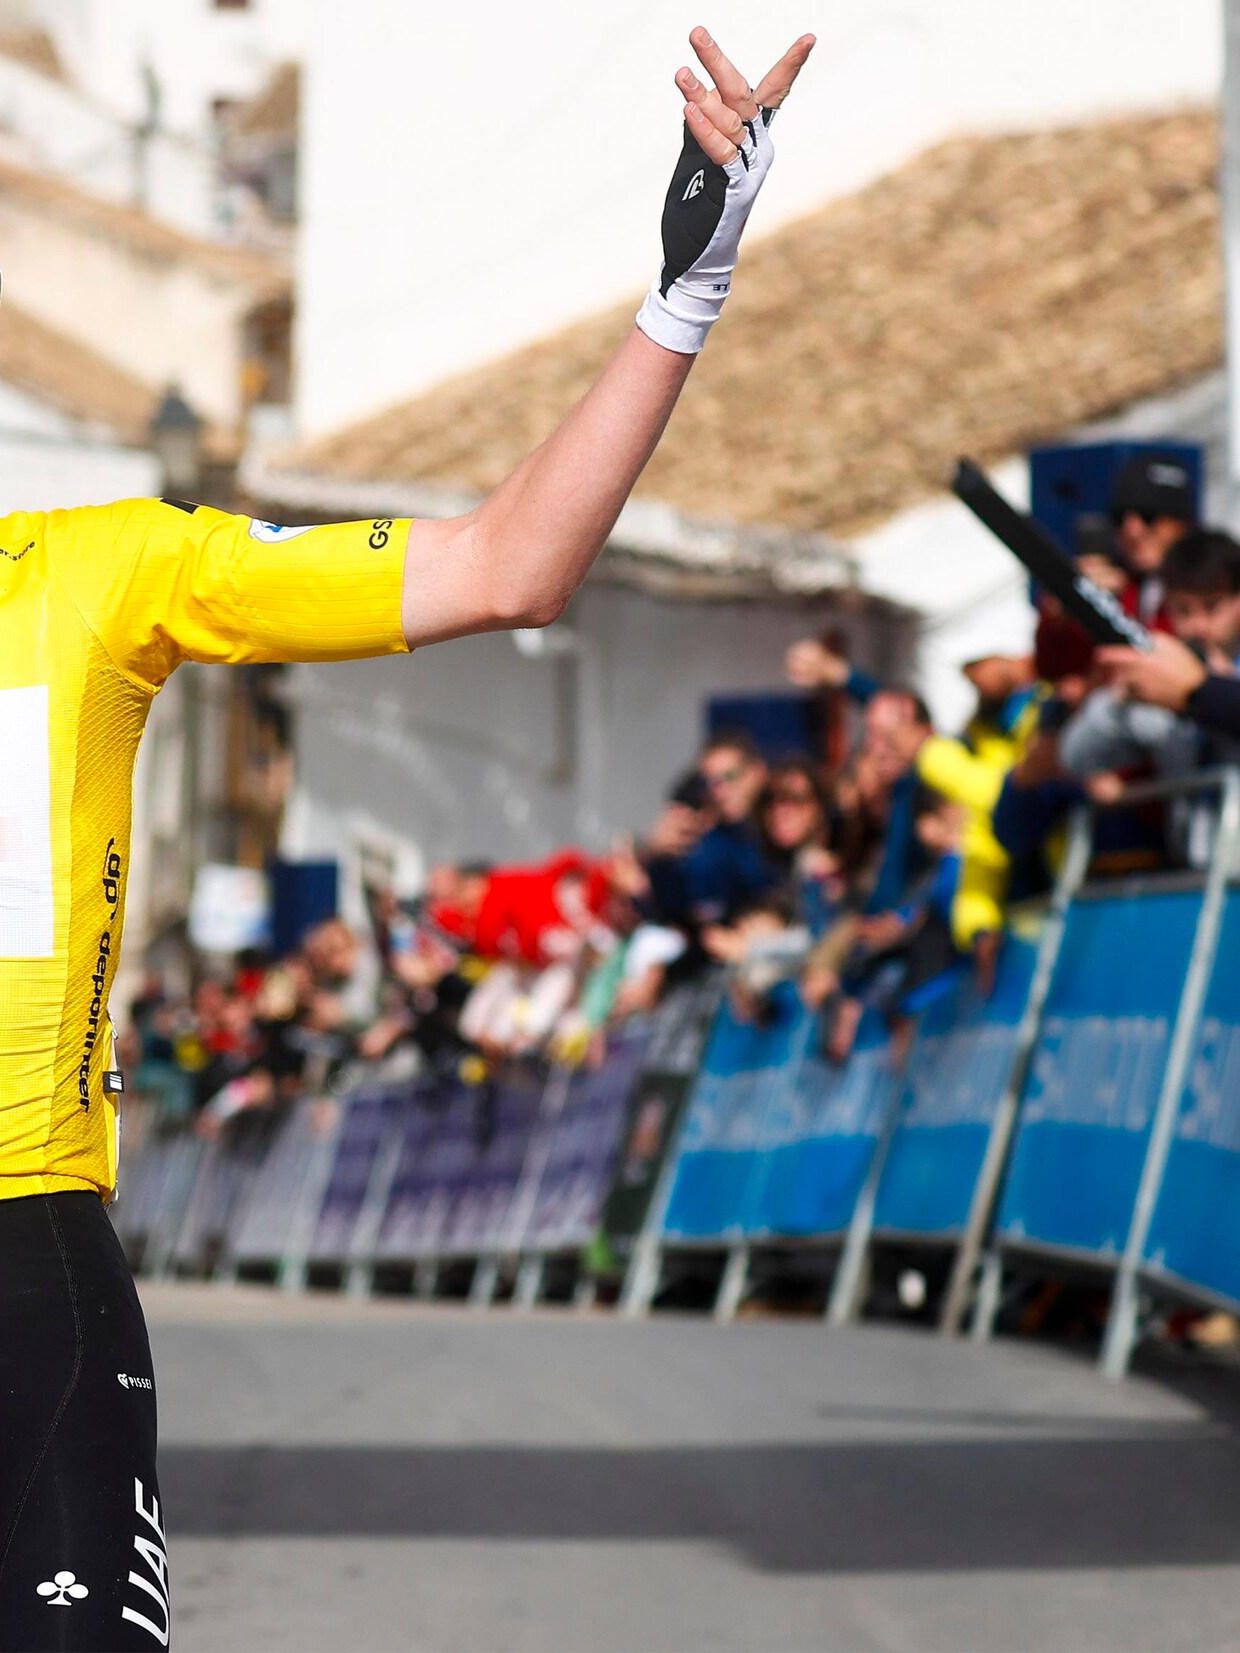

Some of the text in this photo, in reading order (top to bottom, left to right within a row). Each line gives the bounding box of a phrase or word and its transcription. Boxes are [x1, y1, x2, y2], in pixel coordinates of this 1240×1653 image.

[368, 519, 393, 550] GS
[129, 1376, 153, 1390] PISSEI
[122, 1476, 170, 1647] UAE
